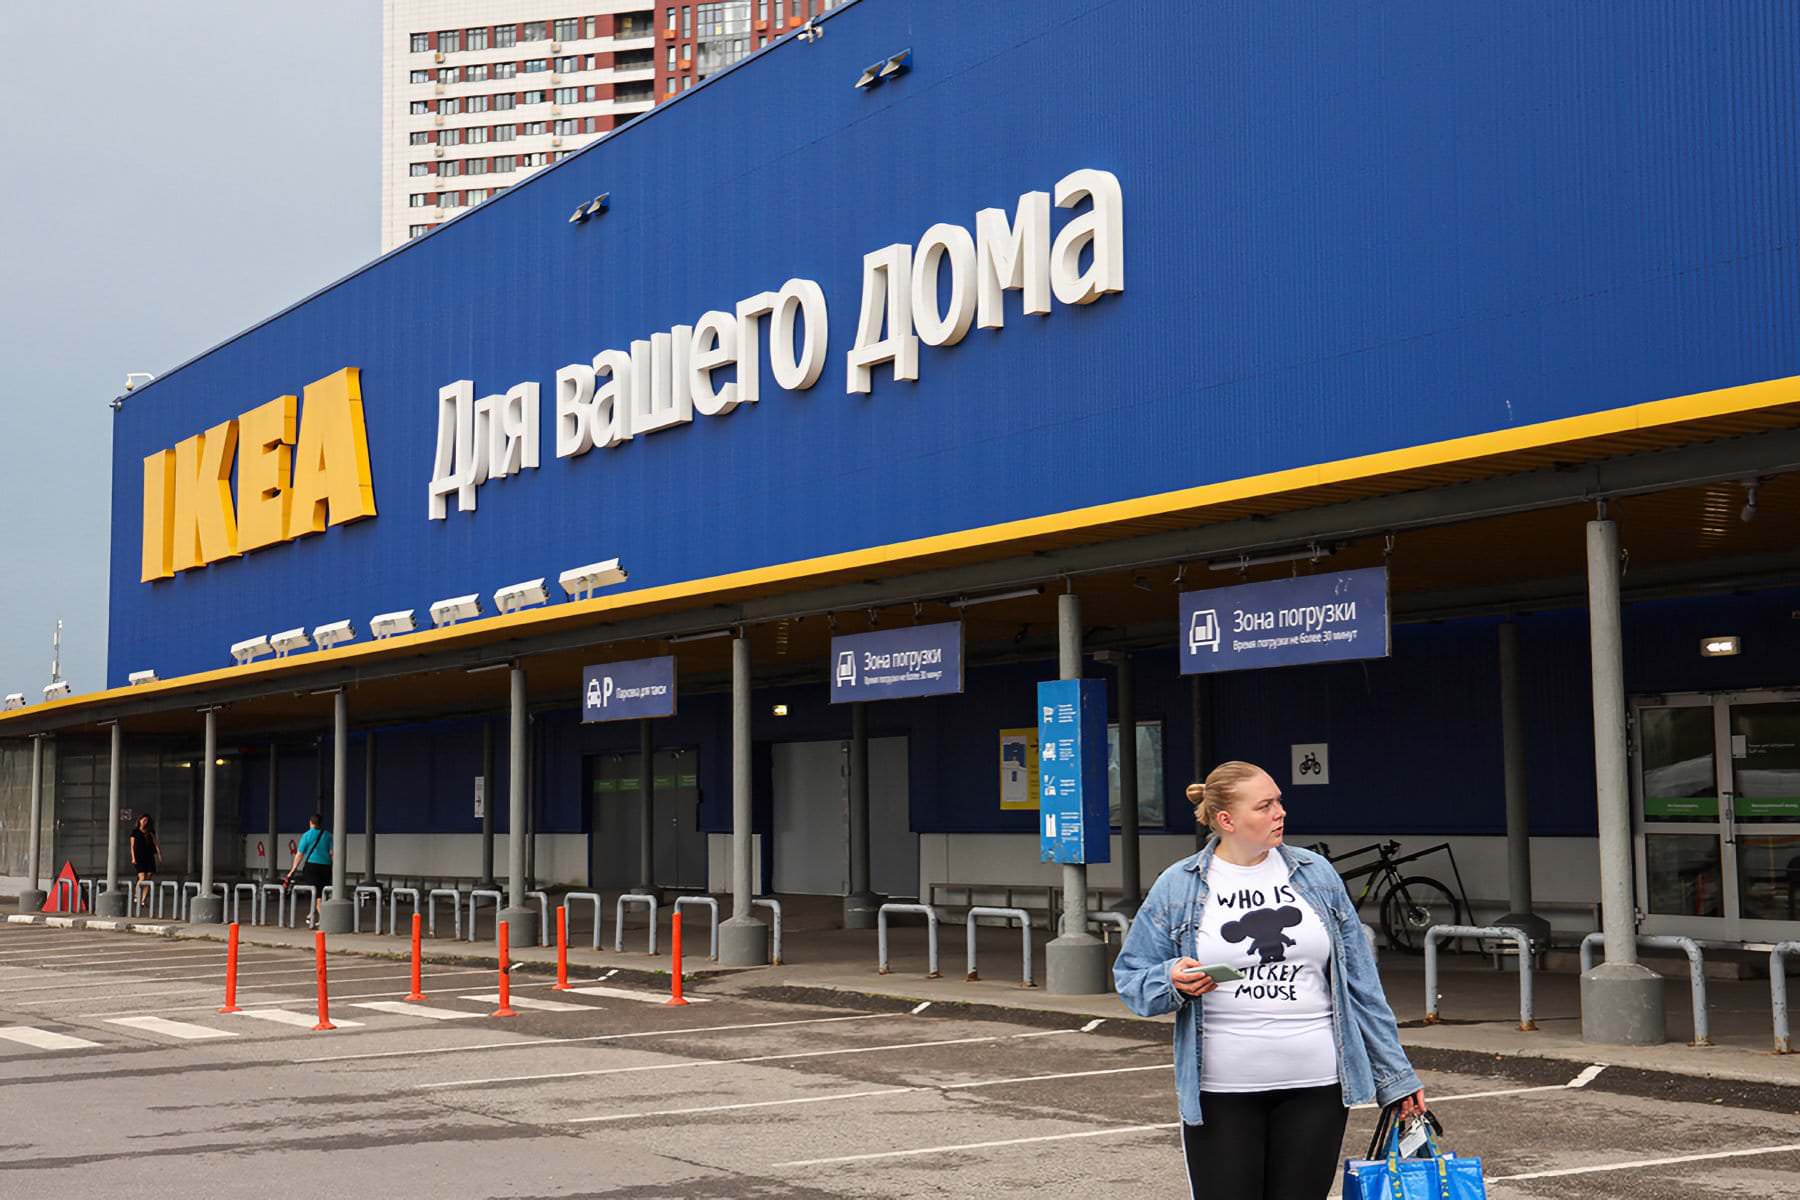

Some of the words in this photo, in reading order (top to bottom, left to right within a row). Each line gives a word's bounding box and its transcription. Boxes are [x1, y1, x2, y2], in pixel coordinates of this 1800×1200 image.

[428, 379, 540, 520] Для
[556, 278, 829, 458] вашего
[846, 168, 1125, 394] дома
[141, 366, 378, 583] IKEA
[1232, 609, 1274, 633] Зона
[1279, 601, 1356, 632] погрузки
[1299, 632, 1322, 644] более
[1322, 630, 1332, 642] 30
[863, 651, 890, 671] Зона
[892, 648, 942, 671] погрузки
[1217, 889, 1265, 909] WHO
[1274, 885, 1296, 904] IS
[1234, 984, 1298, 1001] MOUSE
